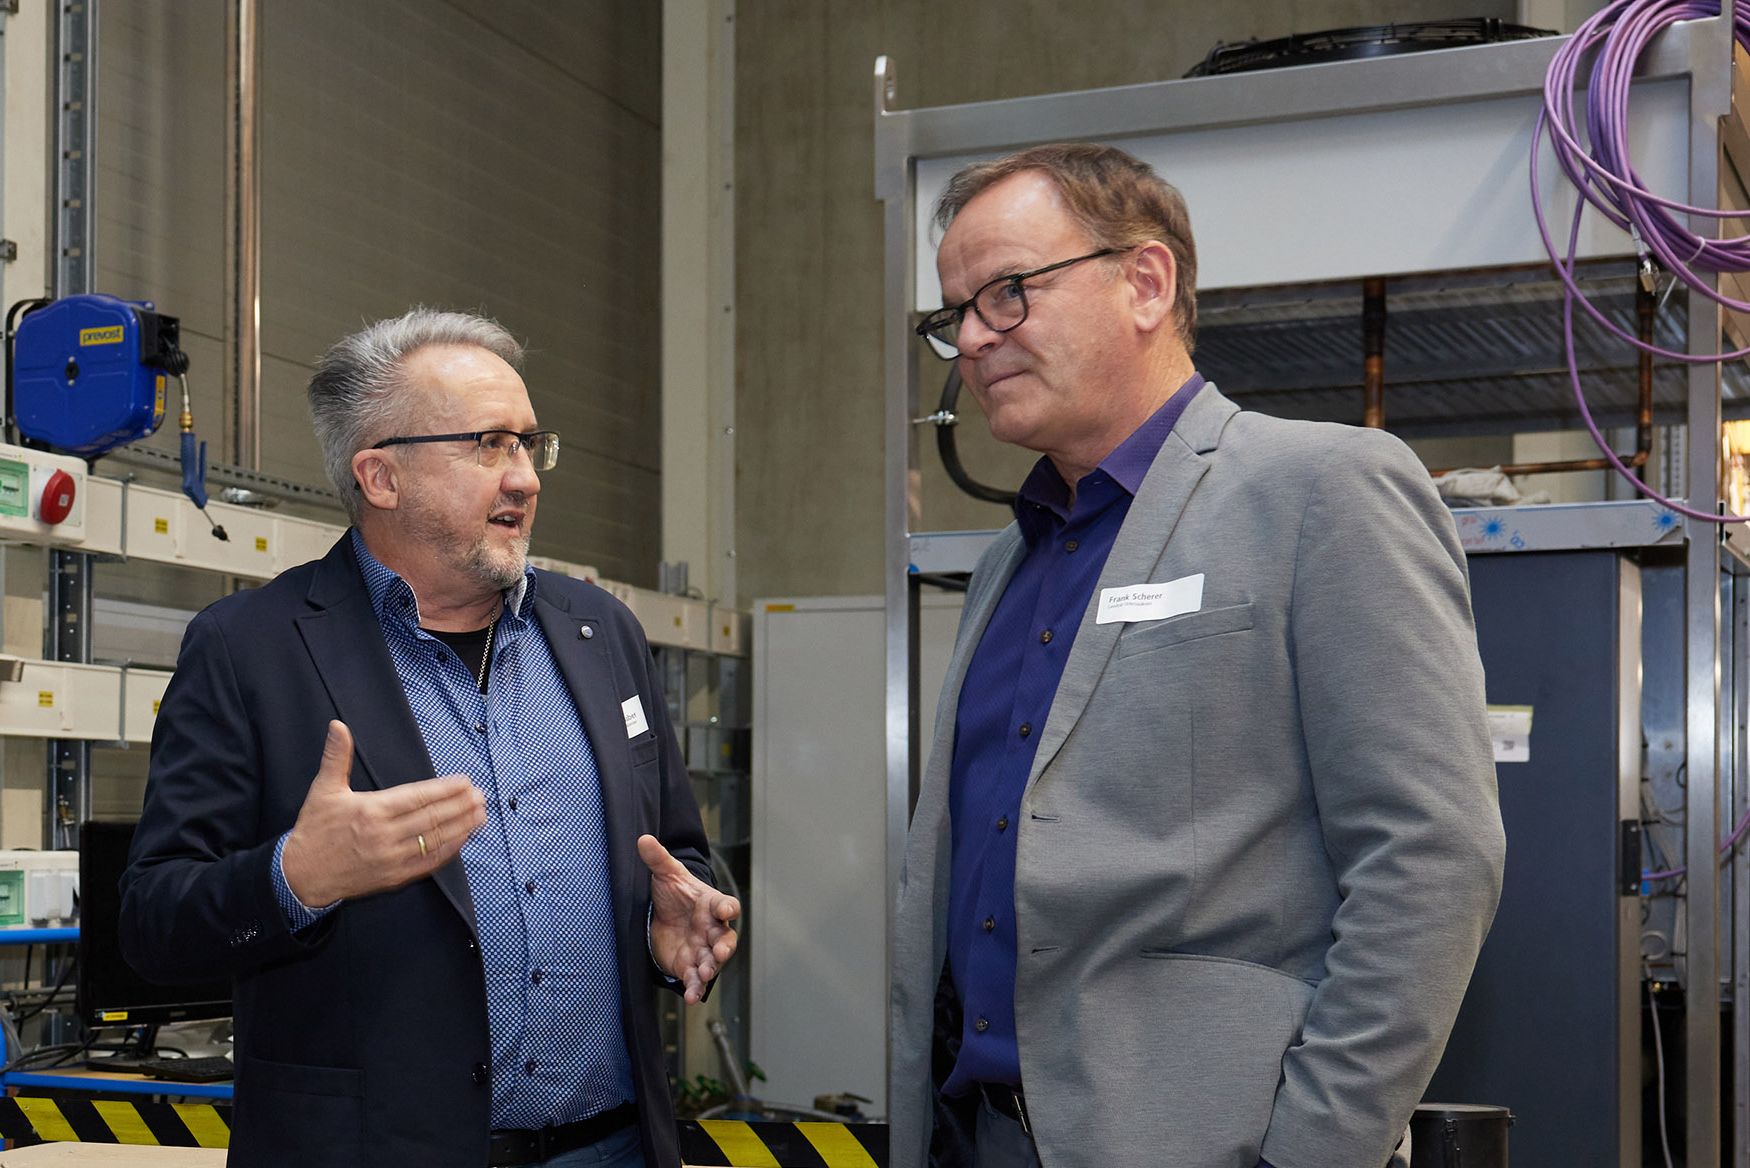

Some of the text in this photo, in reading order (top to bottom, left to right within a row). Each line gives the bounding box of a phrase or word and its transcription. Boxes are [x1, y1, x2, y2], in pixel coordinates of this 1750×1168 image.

[83, 328, 121, 344] prevost
[1108, 592, 1163, 603] Frank Scherer
